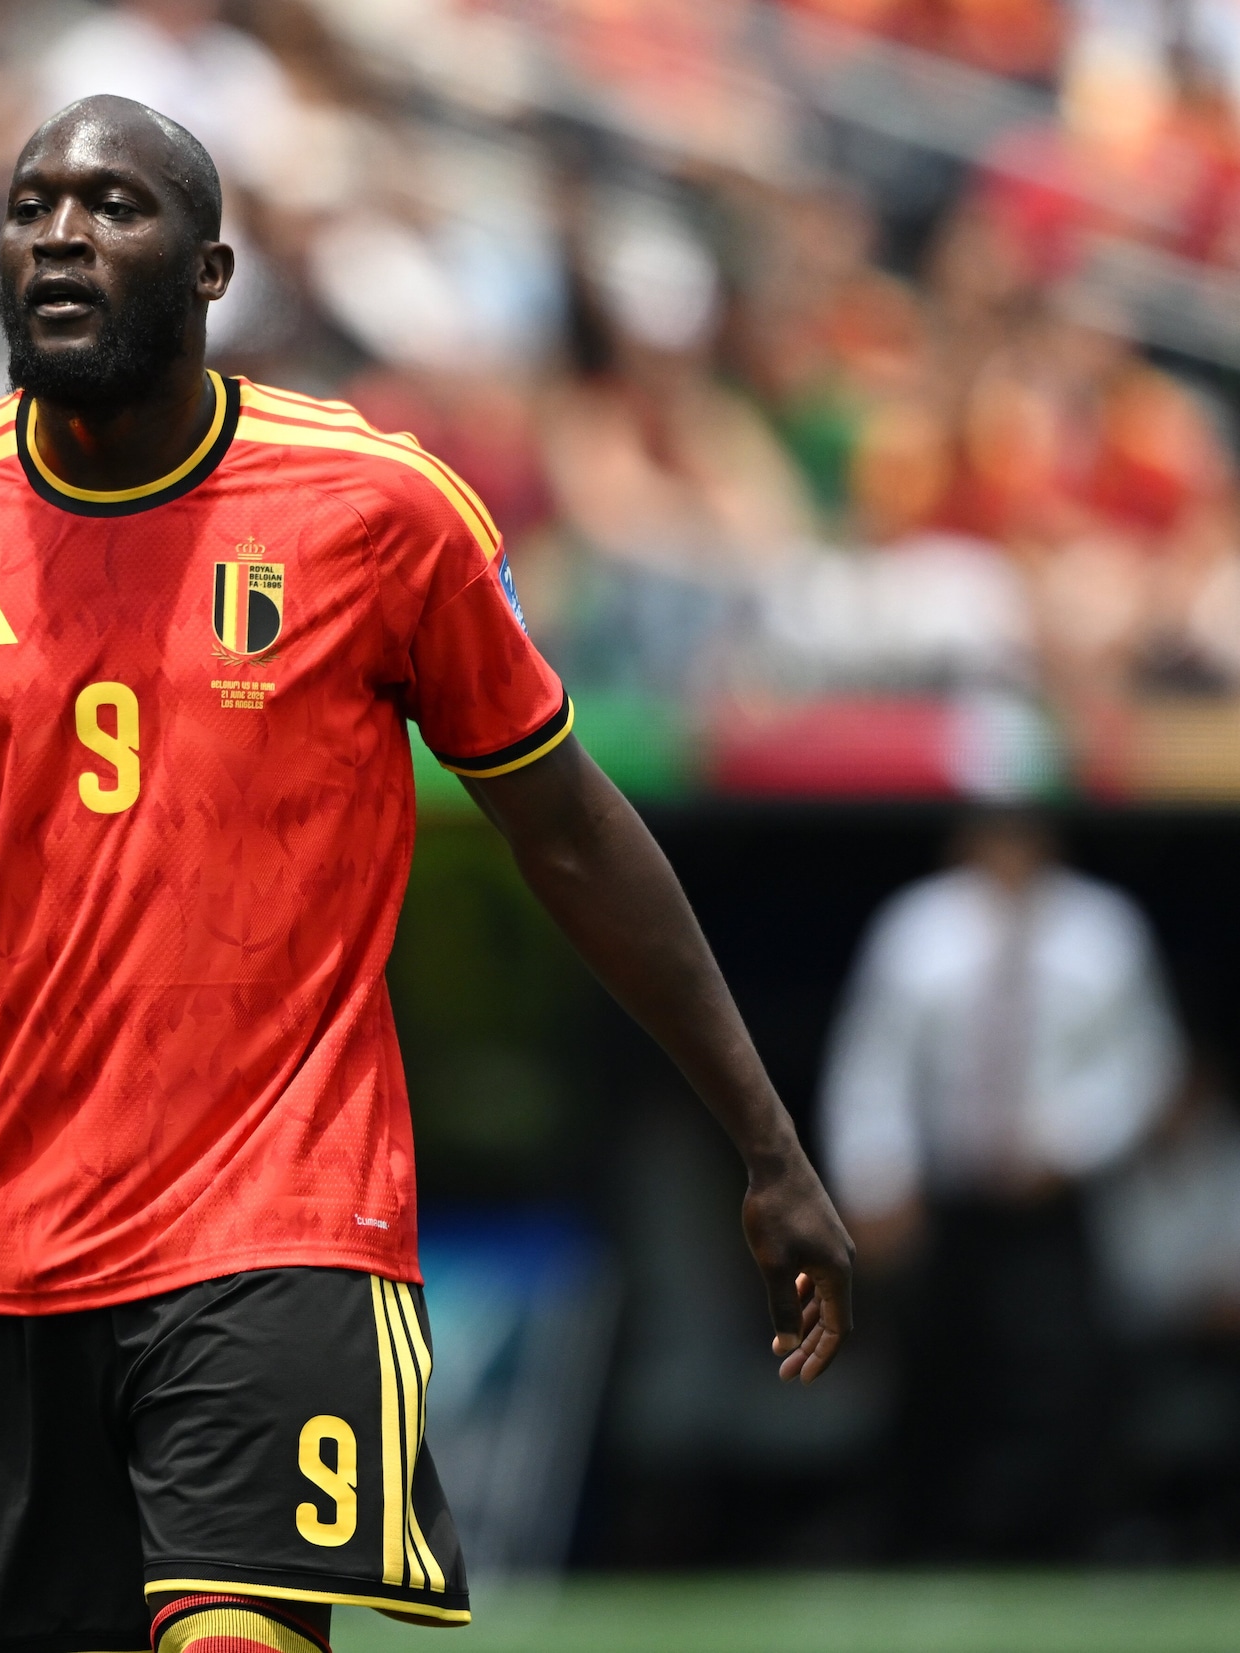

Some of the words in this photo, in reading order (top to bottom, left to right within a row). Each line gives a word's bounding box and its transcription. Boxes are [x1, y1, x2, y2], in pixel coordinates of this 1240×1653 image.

[249, 565, 274, 573] ROYAL
[249, 573, 282, 581] BELGIAN
[211, 680, 240, 690] BELGIUM
[251, 682, 259, 690] IR
[260, 682, 276, 691] IRAN
[221, 689, 229, 698] 21
[230, 690, 246, 699] JUNE
[247, 691, 265, 700] 2026
[221, 699, 234, 708] LOS
[235, 700, 264, 710] ANGELES
[75, 681, 140, 814] 9
[295, 1414, 357, 1547] 9
